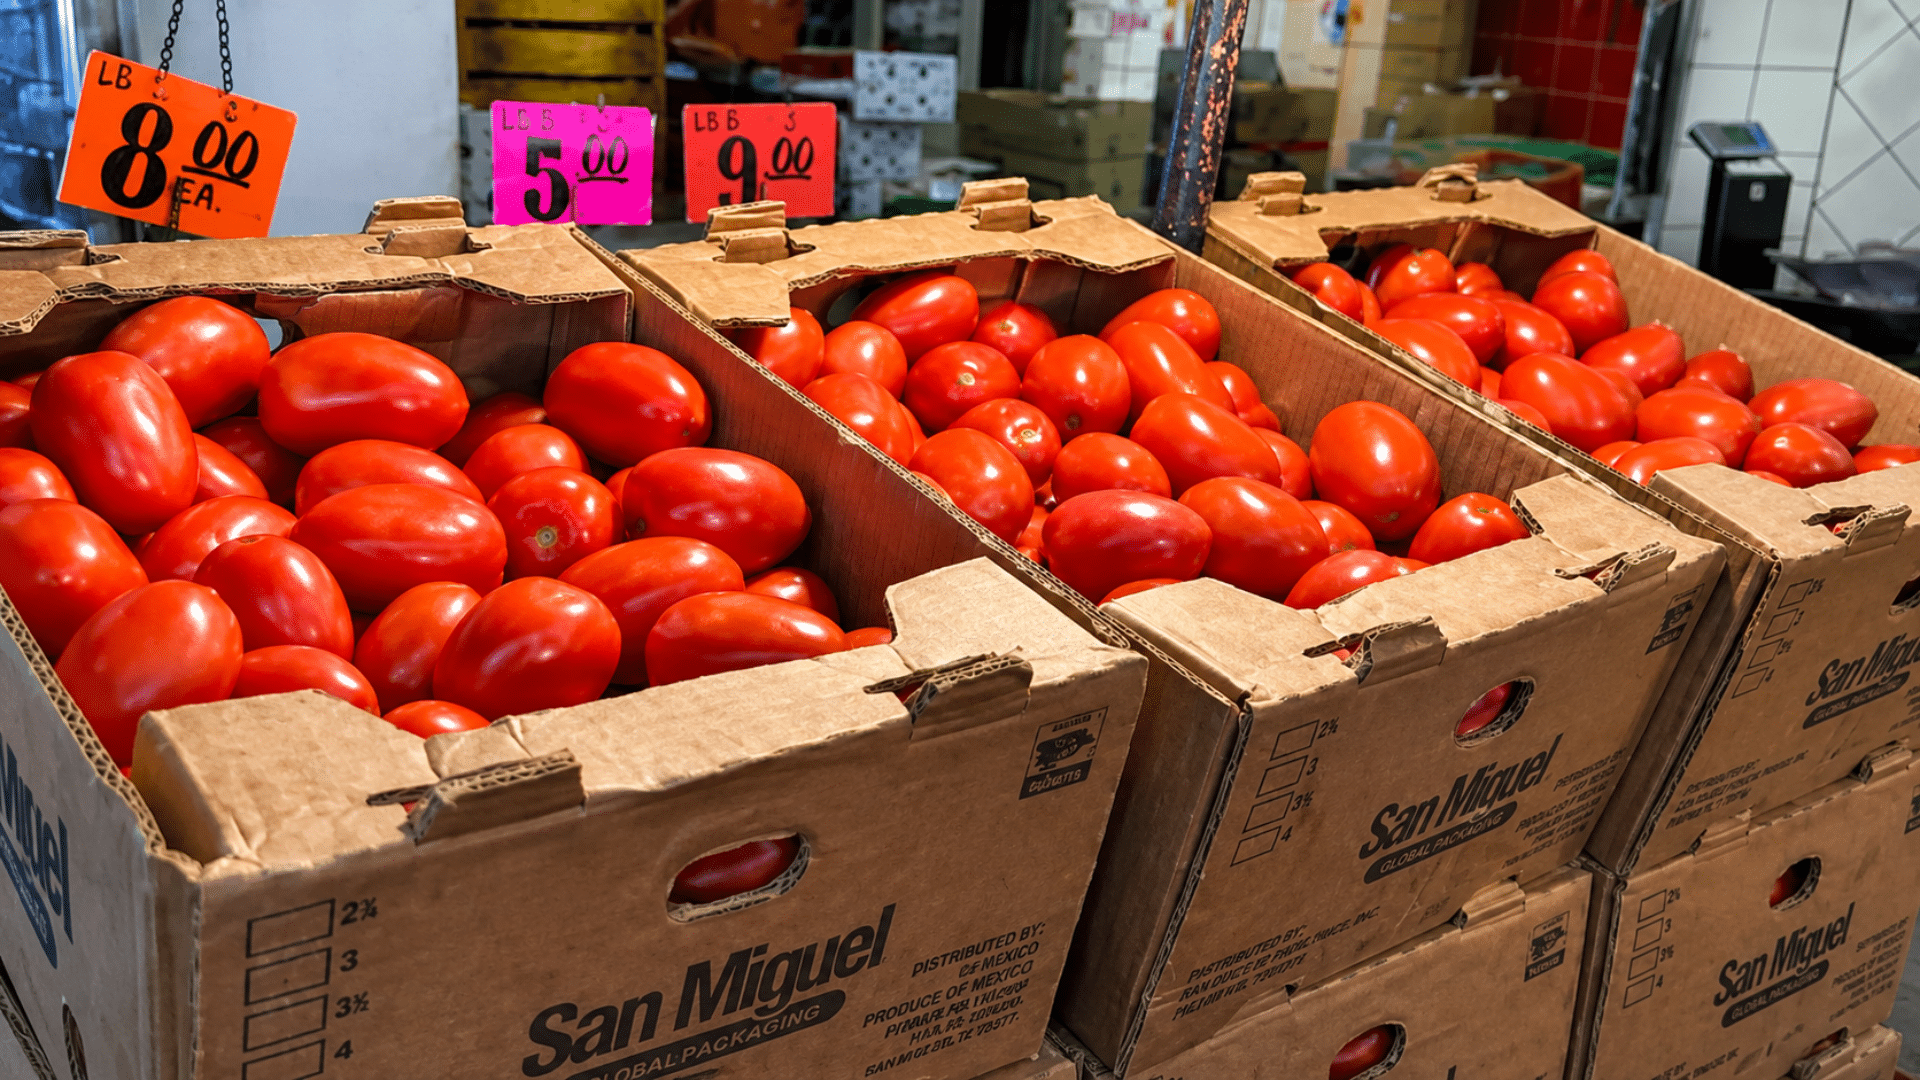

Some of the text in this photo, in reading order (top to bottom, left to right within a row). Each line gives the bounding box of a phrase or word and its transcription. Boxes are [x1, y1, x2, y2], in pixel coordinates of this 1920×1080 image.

[98, 61, 132, 90] LB
[1805, 656, 1866, 707] San
[1306, 757, 1319, 776] 3
[1359, 795, 1441, 860] San
[1434, 732, 1564, 829] Miguel
[1280, 825, 1293, 842] 4
[1378, 841, 1431, 875] GLOBAL
[340, 949, 358, 972] 3
[981, 941, 1039, 972] MEXICO
[1713, 953, 1768, 1007] San
[1768, 901, 1856, 981] Miguel
[521, 990, 663, 1077] San
[673, 903, 897, 1032] Miguel
[862, 990, 944, 1028] PRODUCE
[945, 983, 969, 1001] OF
[971, 960, 1034, 992] MEXICO
[333, 1039, 354, 1060] 4
[681, 1004, 821, 1064] PACKAGING
